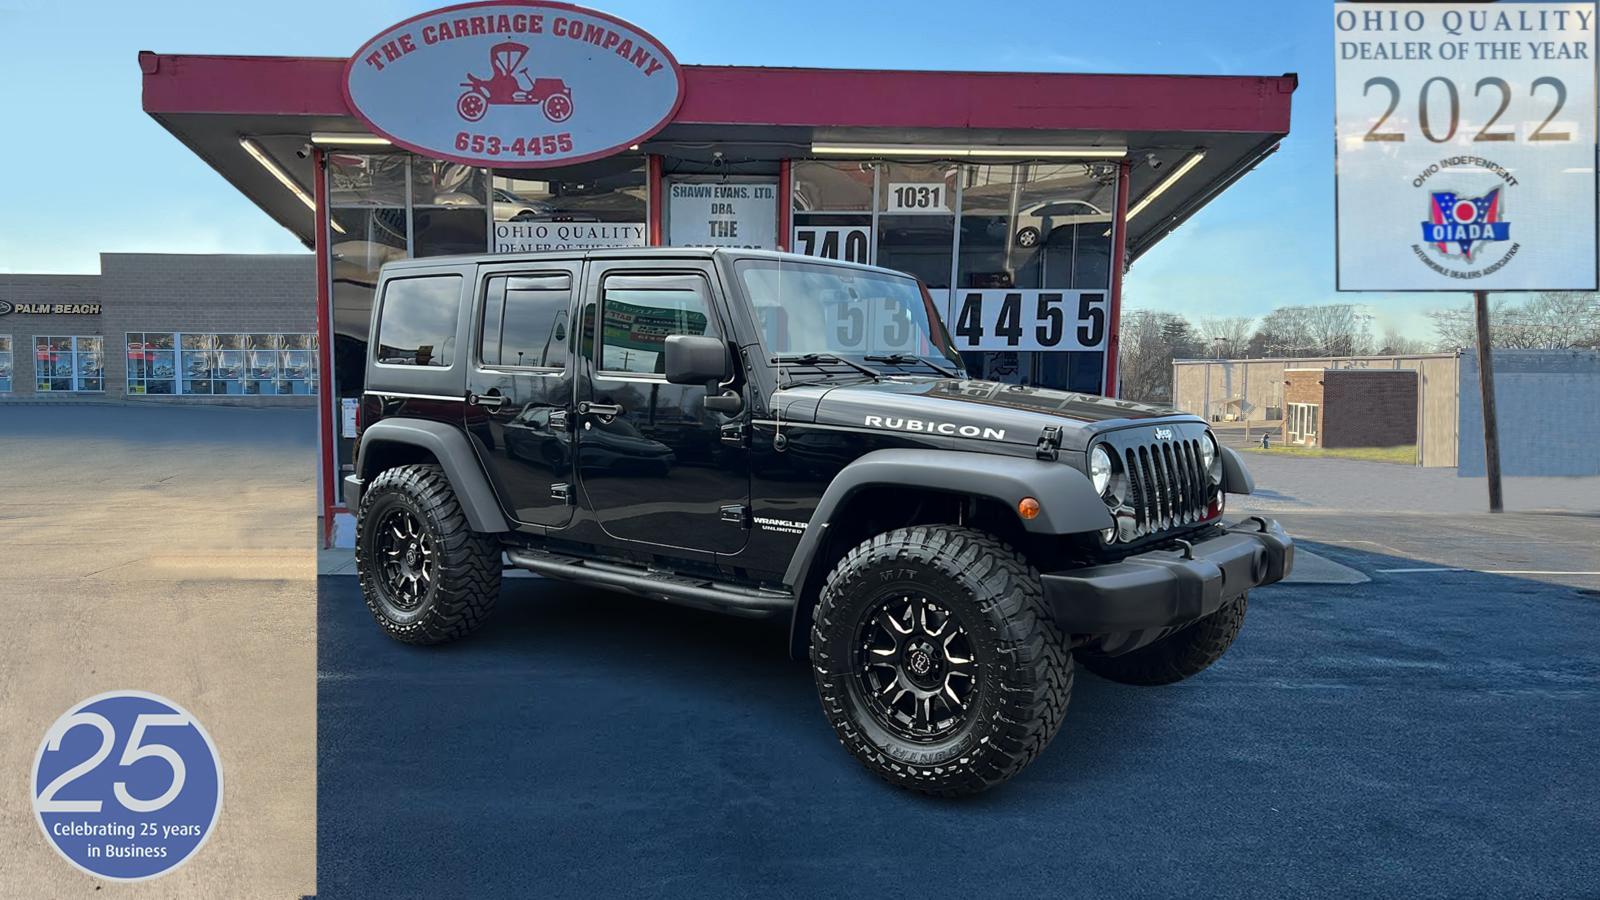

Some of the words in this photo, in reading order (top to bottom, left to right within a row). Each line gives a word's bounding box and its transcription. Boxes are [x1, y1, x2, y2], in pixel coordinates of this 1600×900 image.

[1336, 10, 1425, 31] OHIO
[1442, 10, 1593, 36] QUALITY
[366, 34, 416, 72] THE
[422, 14, 544, 45] CARRIAGE
[553, 17, 664, 77] COMPANY
[1340, 41, 1432, 60] DEALER
[1439, 42, 1469, 60] OF
[1475, 42, 1522, 60] THE
[1528, 41, 1589, 60] YEAR
[1362, 76, 1571, 143] 2022
[455, 132, 573, 156] 653-4455
[1412, 164, 1440, 188] OHIO
[1440, 155, 1519, 187] INDEPENDENT
[672, 186, 712, 198] SHAWN
[754, 187, 775, 199] LTD.
[894, 187, 940, 208] 1031
[711, 203, 736, 215] DBA.
[497, 226, 548, 239] OHIO
[557, 226, 644, 241] QUALITY
[708, 220, 738, 238] THE
[1433, 224, 1495, 241] OIADA
[1411, 244, 1449, 276] AUTOMOBILE
[1449, 270, 1482, 280] DEALERS
[1482, 242, 1521, 276] ASSOCIATION
[14, 303, 51, 314] PALM
[54, 303, 100, 314] BEACH
[956, 293, 1105, 347] 4455
[864, 415, 1005, 440] RUBICON
[1155, 427, 1172, 440] Jeep
[753, 516, 809, 529] WRANGLER
[762, 525, 802, 534] UNLIMITED
